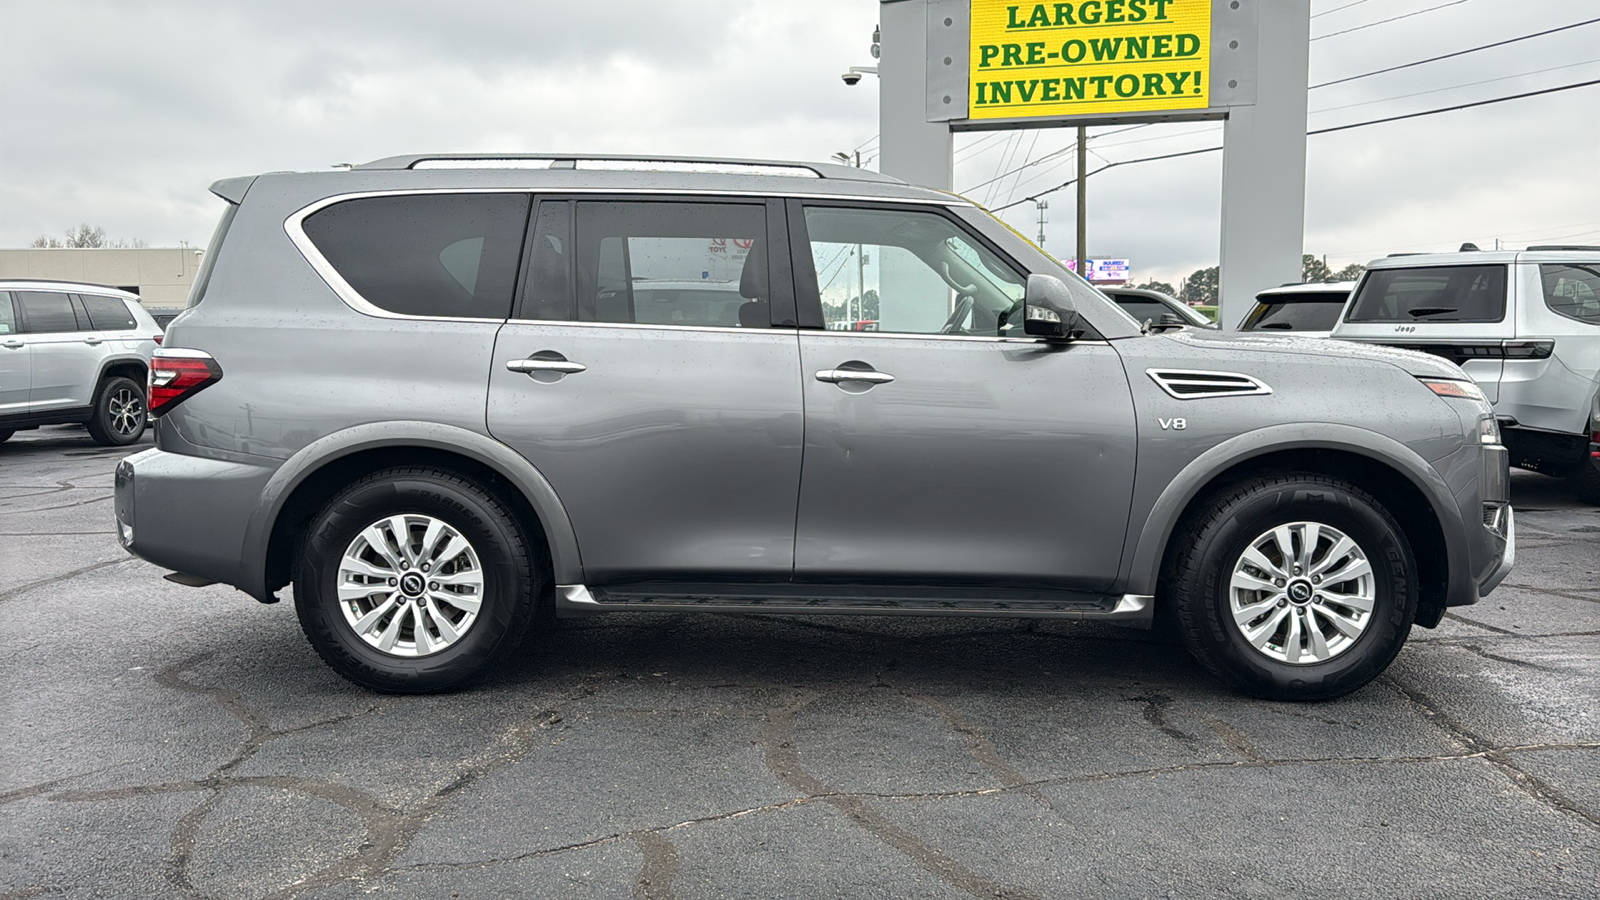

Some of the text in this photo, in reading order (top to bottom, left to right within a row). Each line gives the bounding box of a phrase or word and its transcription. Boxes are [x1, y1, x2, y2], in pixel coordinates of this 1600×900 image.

[1006, 0, 1174, 29] LARGEST
[978, 33, 1201, 68] PRE-OWNED
[975, 70, 1202, 105] INVENTORY!
[1394, 325, 1416, 334] Jeep
[1157, 417, 1187, 431] V8
